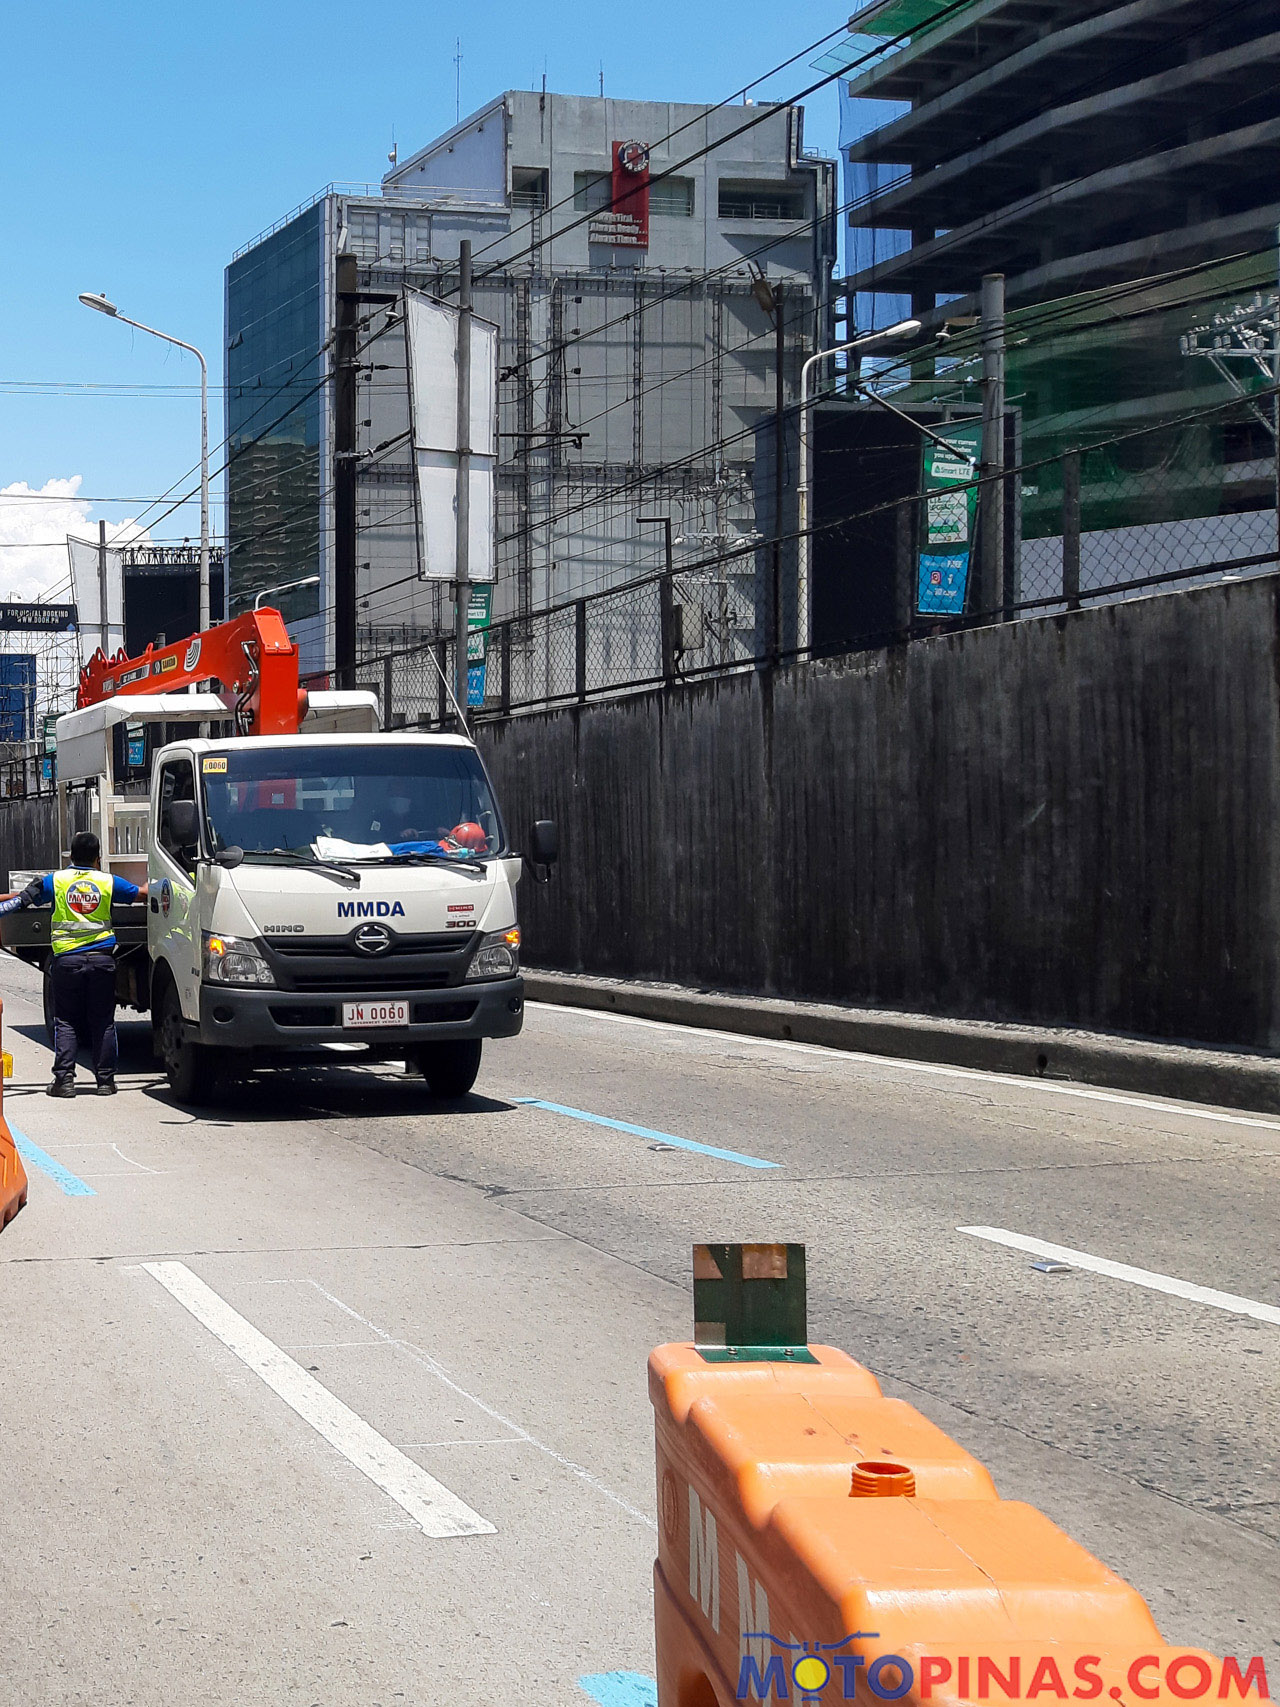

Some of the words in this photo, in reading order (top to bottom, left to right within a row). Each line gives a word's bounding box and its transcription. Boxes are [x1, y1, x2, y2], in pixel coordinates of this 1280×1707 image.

[958, 467, 971, 476] LTE
[68, 894, 99, 902] MMDA
[337, 901, 406, 918] MMDA
[445, 920, 477, 928] 300
[264, 925, 305, 933] HINO
[348, 1007, 364, 1021] JN
[370, 1006, 404, 1020] 0060
